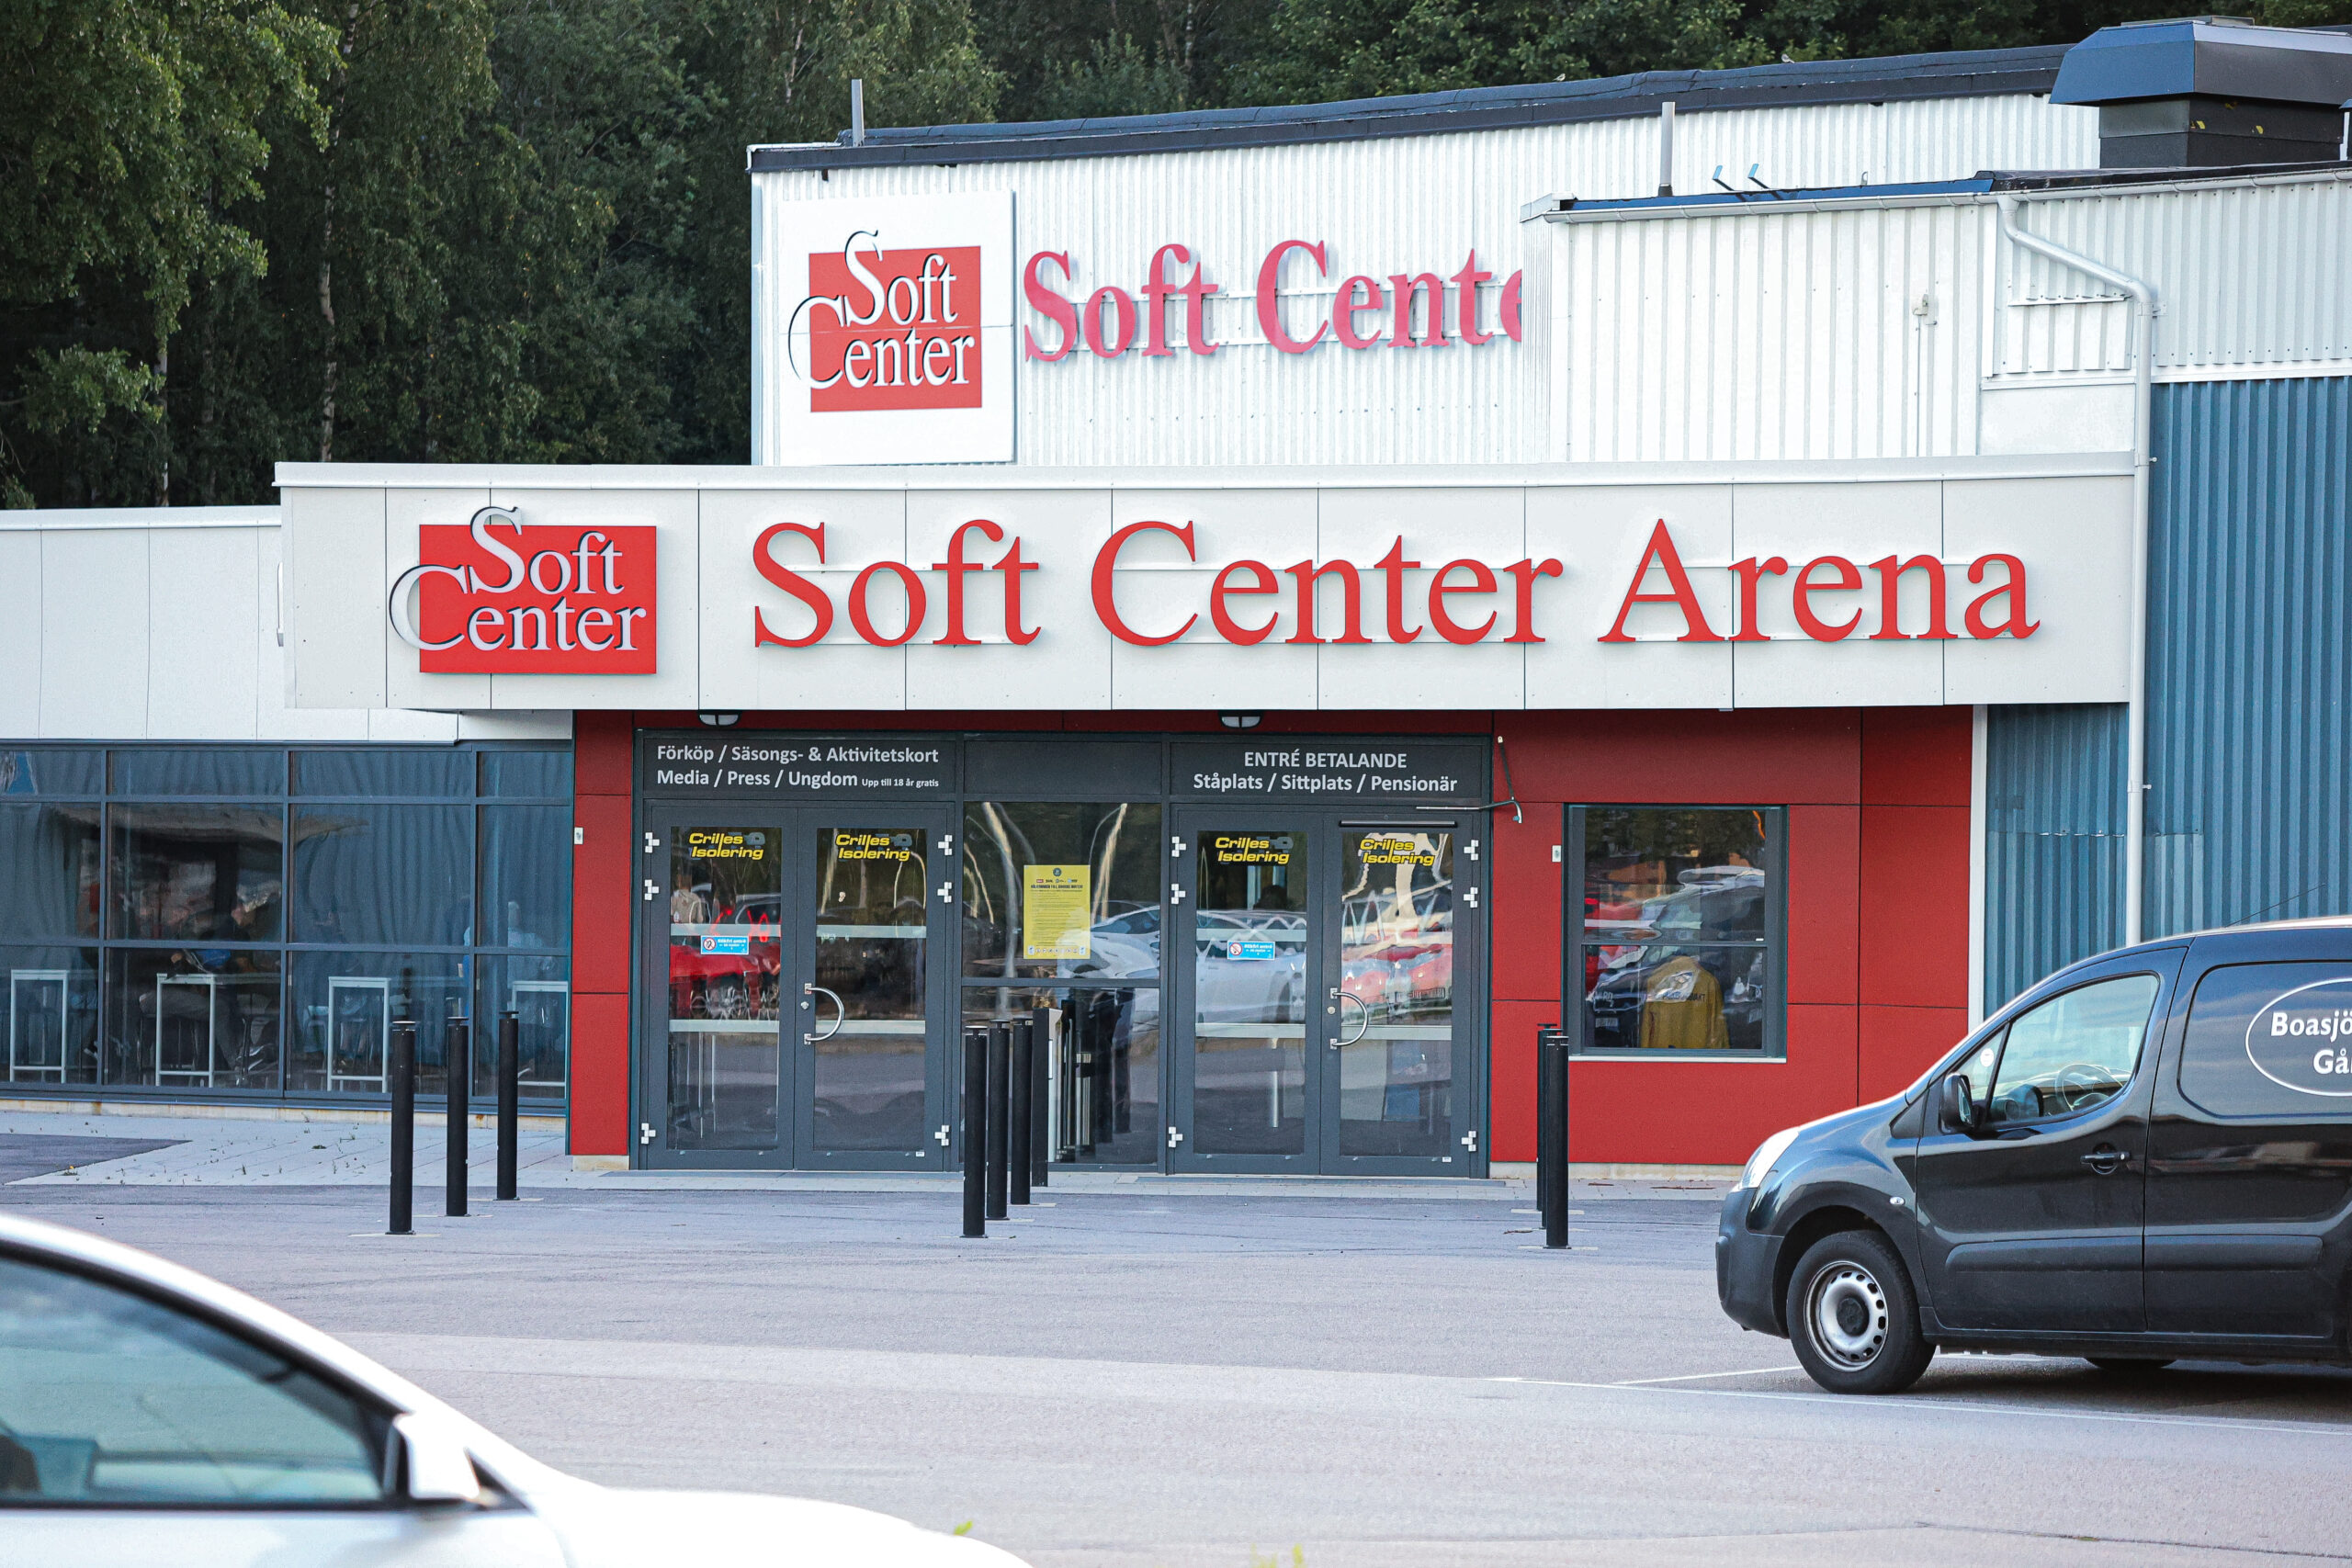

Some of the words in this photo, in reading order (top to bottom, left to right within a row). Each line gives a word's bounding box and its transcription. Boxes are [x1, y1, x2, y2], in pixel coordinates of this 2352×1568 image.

[844, 229, 958, 327] Soft
[1024, 244, 1218, 361] Soft
[788, 294, 976, 391] Center
[468, 506, 624, 595] Soft
[754, 520, 1040, 648] Soft
[1091, 520, 1563, 646] Center
[1598, 518, 2041, 642] Arena
[389, 564, 647, 652] Center
[657, 745, 714, 763] Förköp
[718, 744, 728, 763] /
[731, 746, 804, 764] Säsongs-
[808, 747, 822, 761] &
[826, 746, 939, 763] Aktivitetskort
[1244, 748, 1300, 768] ENTRÉ
[1306, 752, 1408, 769] BETALANDE
[657, 769, 709, 785] Media
[713, 769, 723, 788] /
[728, 771, 771, 785] Press
[775, 770, 785, 788] /
[788, 771, 858, 789] Ungdom
[861, 778, 879, 788] Upp
[880, 778, 892, 786] till
[894, 778, 904, 787] 18
[905, 777, 915, 787] år
[916, 778, 939, 788] gratis
[1193, 773, 1263, 793] Ståplats
[1267, 773, 1277, 793] /
[1281, 773, 1352, 794] Sittplats
[1356, 773, 1367, 794] /
[1371, 775, 1458, 792] Pensionär
[689, 832, 743, 846] Crilles
[835, 834, 890, 847] Crilles
[1215, 837, 1270, 850] Crilles
[1360, 838, 1415, 852] Crilles
[692, 846, 763, 861] Isolering
[838, 847, 910, 862] Isolering
[1217, 850, 1290, 864] Isolering
[1363, 852, 1435, 866] Isolering
[2270, 1010, 2352, 1043] Boasjö
[2312, 1047, 2352, 1075] Gå
